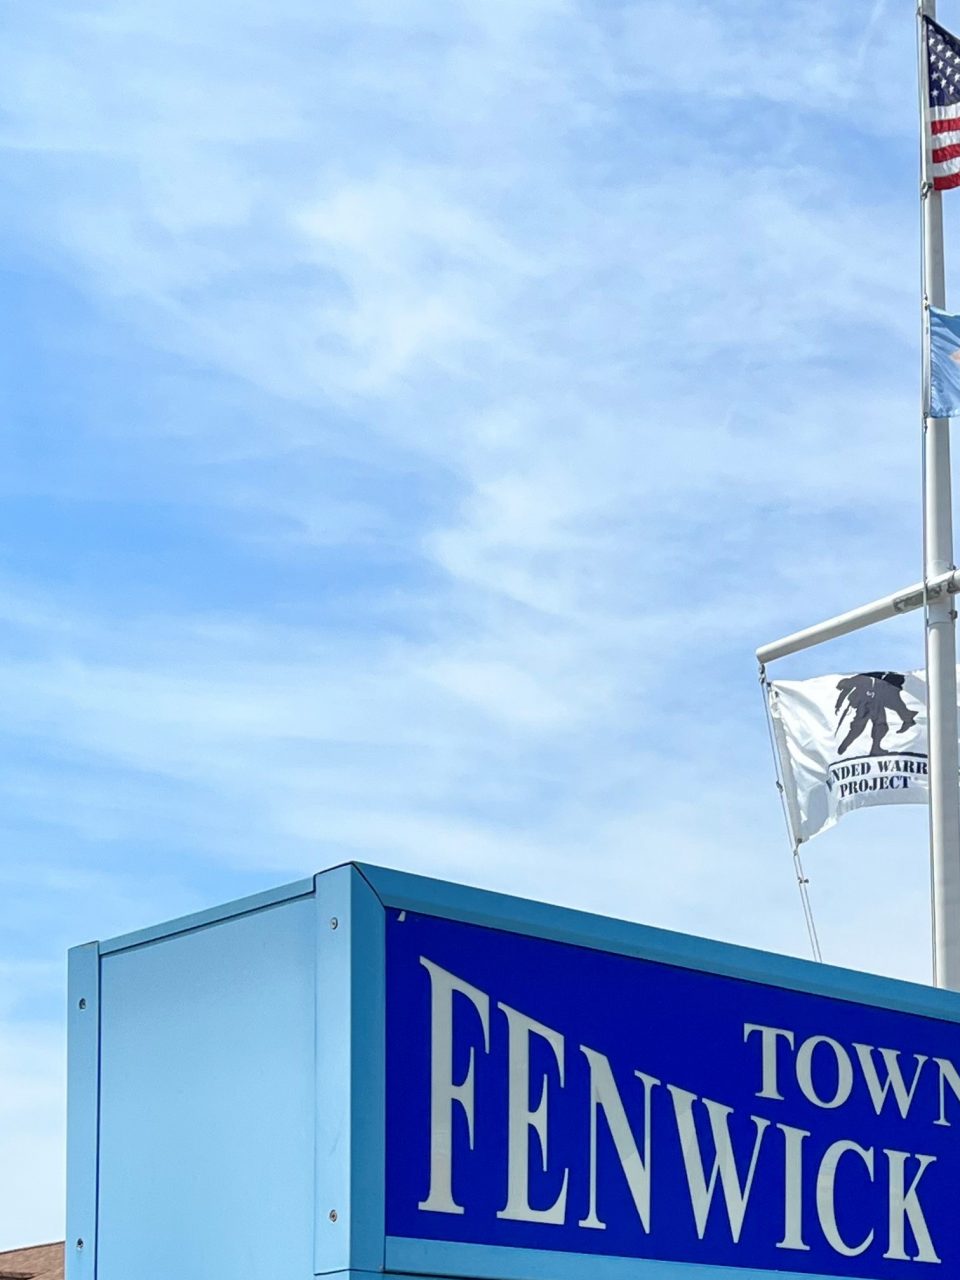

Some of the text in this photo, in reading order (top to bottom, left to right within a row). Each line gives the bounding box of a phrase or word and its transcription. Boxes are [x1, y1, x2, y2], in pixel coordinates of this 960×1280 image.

[877, 760, 928, 774] WARR
[840, 775, 911, 798] PROJECT
[418, 955, 943, 1265] FENWICK
